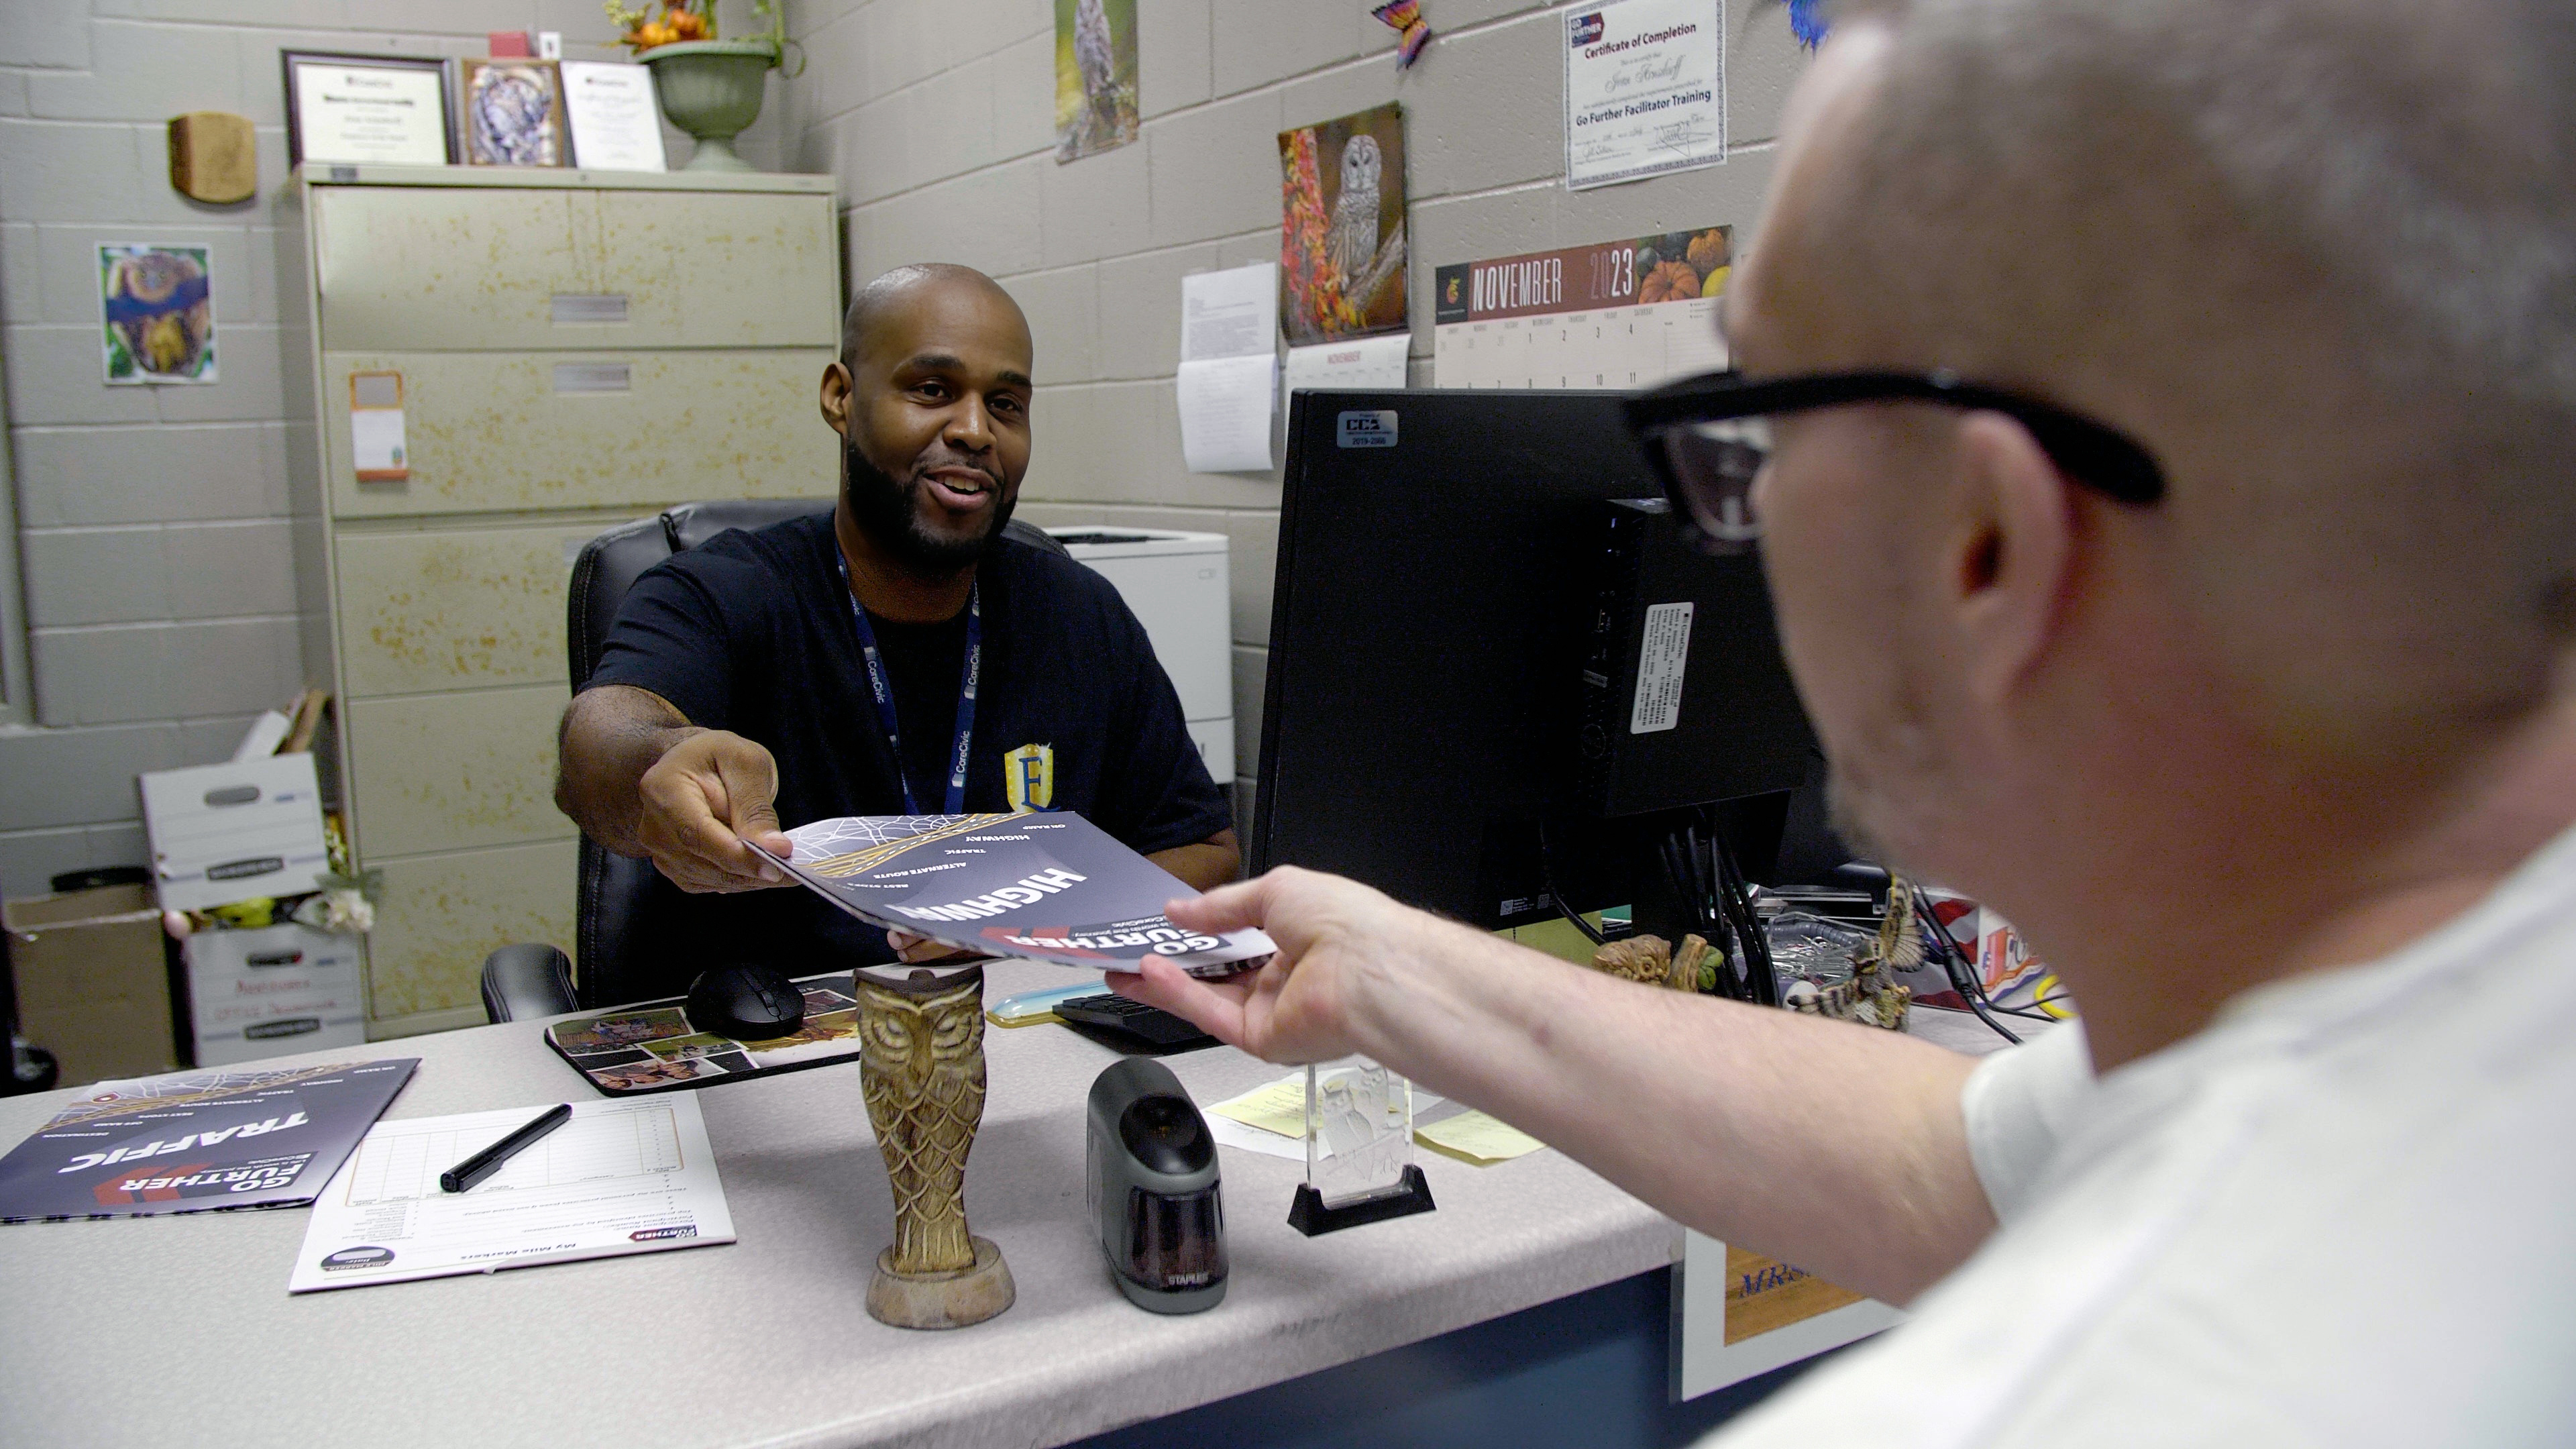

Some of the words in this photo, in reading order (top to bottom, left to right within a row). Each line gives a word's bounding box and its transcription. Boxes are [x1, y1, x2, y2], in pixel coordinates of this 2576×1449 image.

[1585, 39, 1629, 59] Certificate
[1631, 34, 1641, 47] of
[1643, 23, 1697, 45] Completion
[1576, 115, 1588, 127] Go
[1590, 107, 1623, 123] Further
[1625, 98, 1670, 116] Facilitator
[1672, 89, 1711, 107] Training
[1473, 258, 1562, 312] NOVEMBER
[1590, 248, 1633, 301] 2023
[1562, 329, 1567, 341] 2
[1596, 326, 1601, 339] 3
[1629, 323, 1633, 335] 4
[1596, 373, 1603, 387] 10
[1629, 371, 1636, 384] 11
[968, 644, 980, 686] CoreCivic
[867, 660, 884, 704] CoreCivic
[956, 731, 971, 773] CoreCivic
[873, 869, 909, 879] ROUTE
[910, 862, 967, 875] ALTERNATE
[1112, 916, 1164, 928] CoreCivic
[1153, 936, 1220, 955] GO
[58, 1112, 309, 1173] TRAFFIC
[120, 1164, 304, 1191] FURTHER
[230, 1176, 292, 1192] GO
[461, 1250, 519, 1260] Markers
